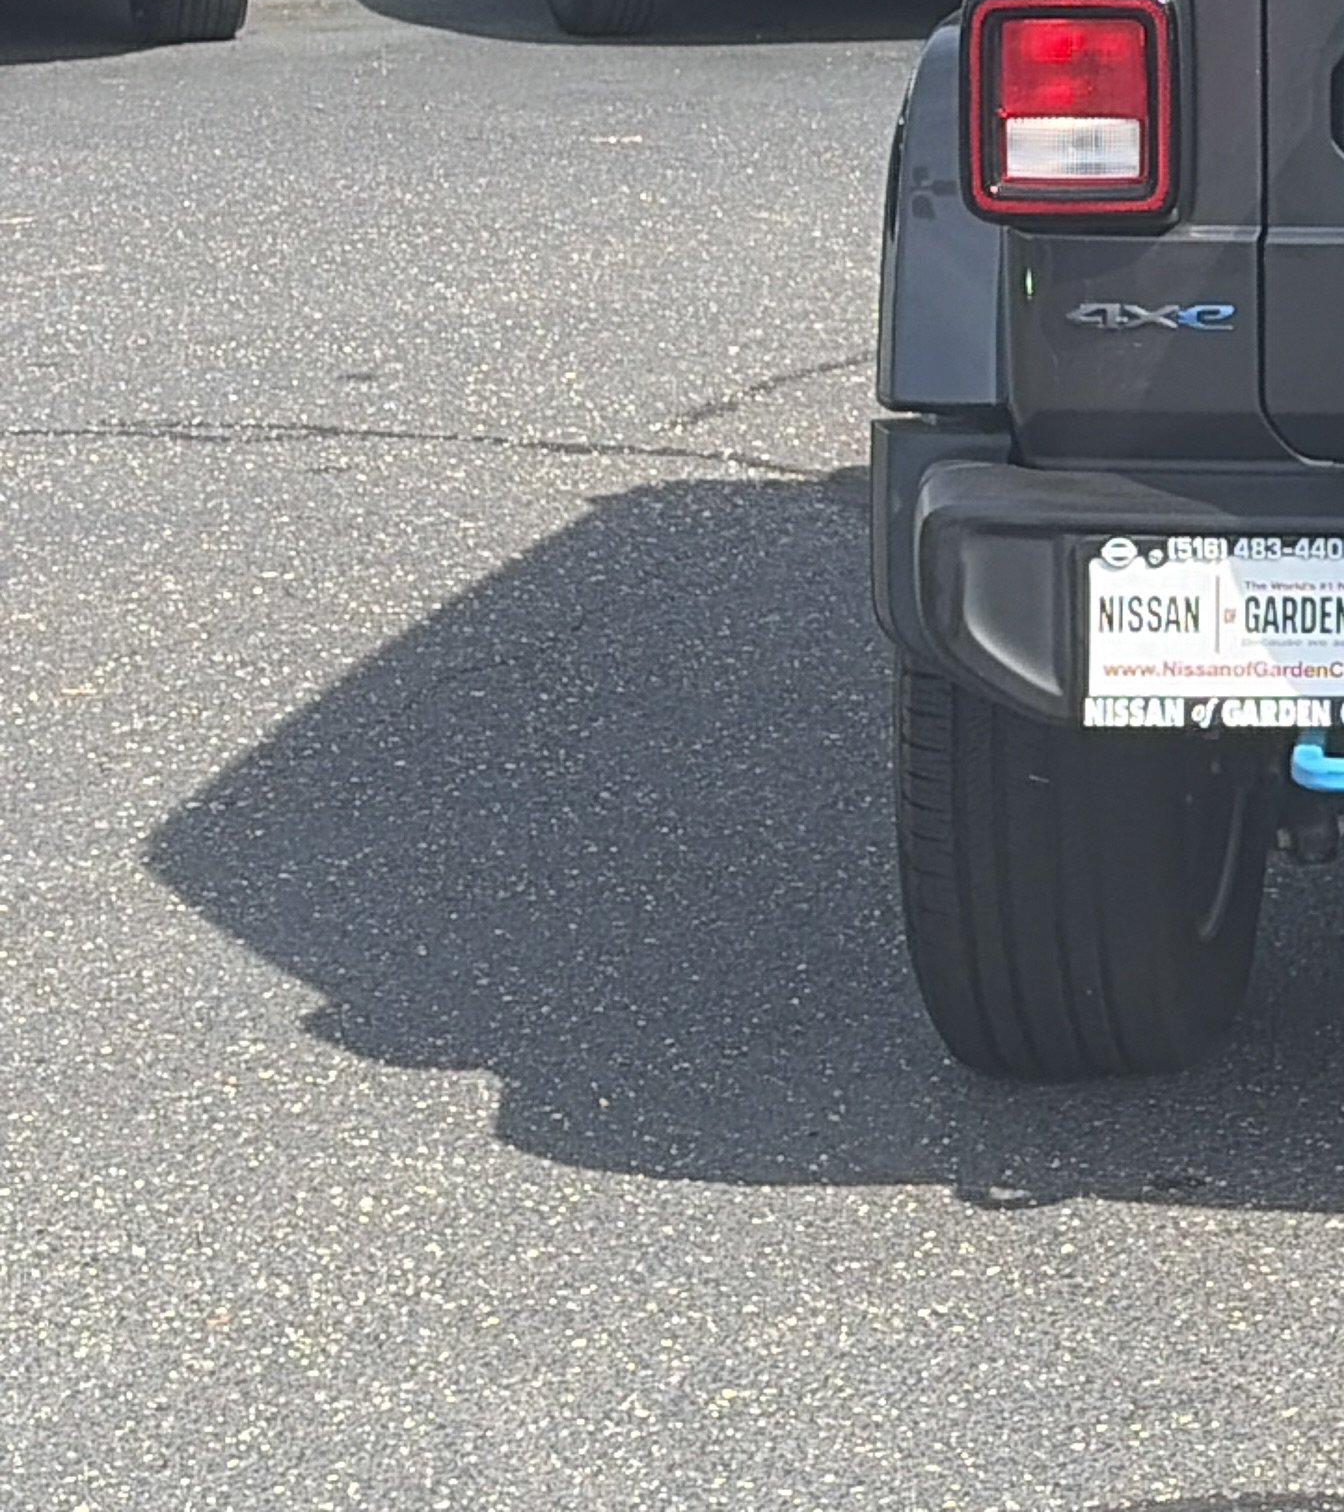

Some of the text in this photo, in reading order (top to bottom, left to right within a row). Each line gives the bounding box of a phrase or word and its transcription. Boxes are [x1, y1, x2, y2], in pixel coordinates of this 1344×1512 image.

[1167, 536, 1228, 560] (516)
[1099, 595, 1200, 633] NISSAN
[1084, 697, 1185, 727] NISSAN
[1191, 697, 1220, 729] of
[1221, 698, 1332, 727] GARDEN
